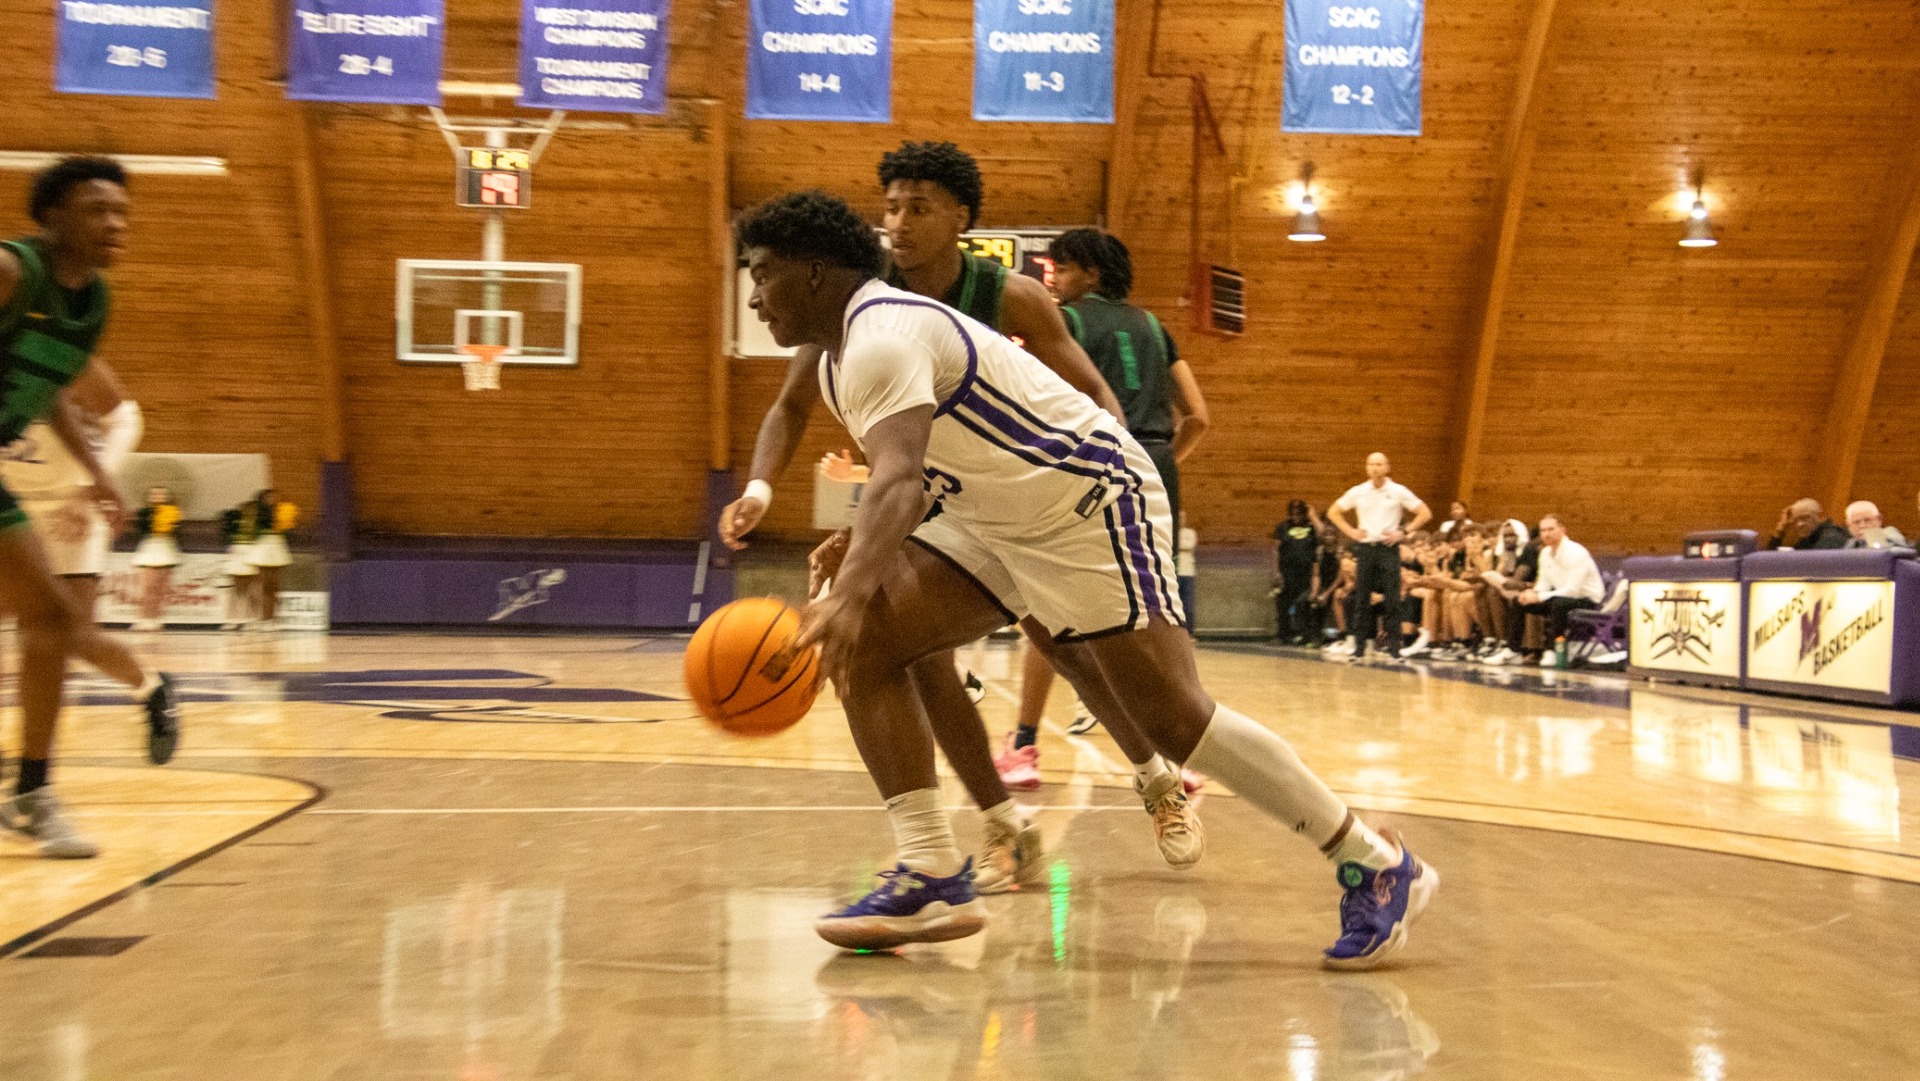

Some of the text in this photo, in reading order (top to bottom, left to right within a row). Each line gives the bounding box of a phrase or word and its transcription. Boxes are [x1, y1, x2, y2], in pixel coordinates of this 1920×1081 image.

[581, 9, 657, 30] DIVISION
[1328, 5, 1381, 30] SCAC
[544, 26, 646, 49] CHAMPIONS
[762, 31, 878, 56] CHAMPIONS
[988, 30, 1101, 54] CHAMPIONS
[1299, 44, 1410, 68] CHAMPIONS
[534, 57, 652, 80] TOURNAMENT
[541, 77, 644, 99] CHAMPIONS
[1023, 71, 1065, 92] 11-3
[1113, 330, 1142, 390] 1
[1753, 590, 1805, 652] MILLSAPS
[1813, 599, 1884, 677] BASKETBALL
